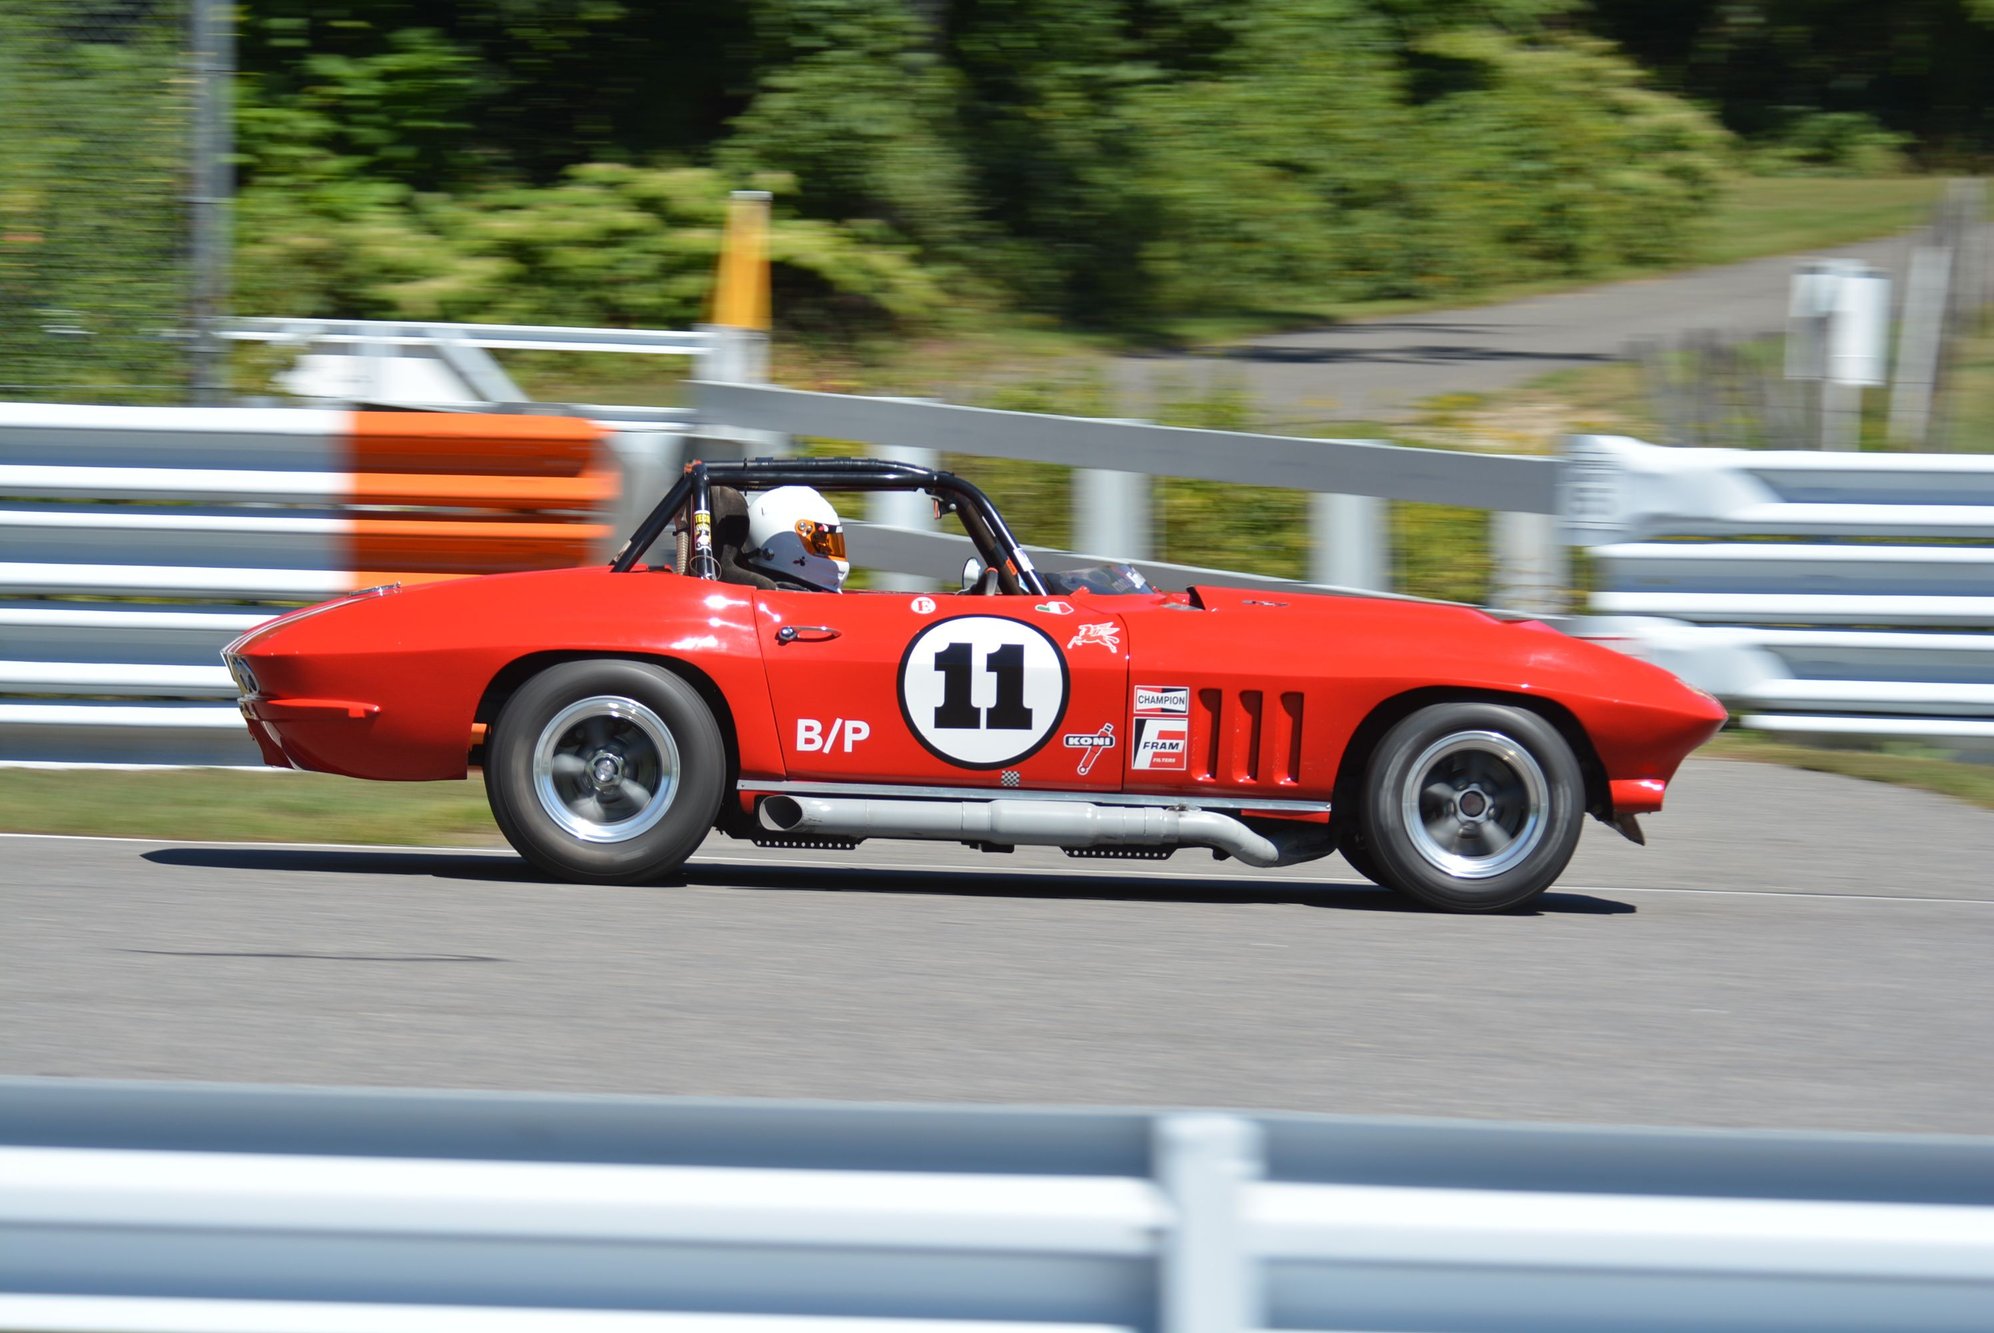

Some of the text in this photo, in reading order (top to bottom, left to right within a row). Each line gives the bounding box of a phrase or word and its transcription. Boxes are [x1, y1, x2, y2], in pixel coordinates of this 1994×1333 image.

[934, 642, 1033, 730] 11
[1138, 695, 1185, 705] CHAMPION
[796, 717, 870, 754] B/P
[1068, 737, 1111, 746] KONI
[1142, 741, 1180, 750] FRAM
